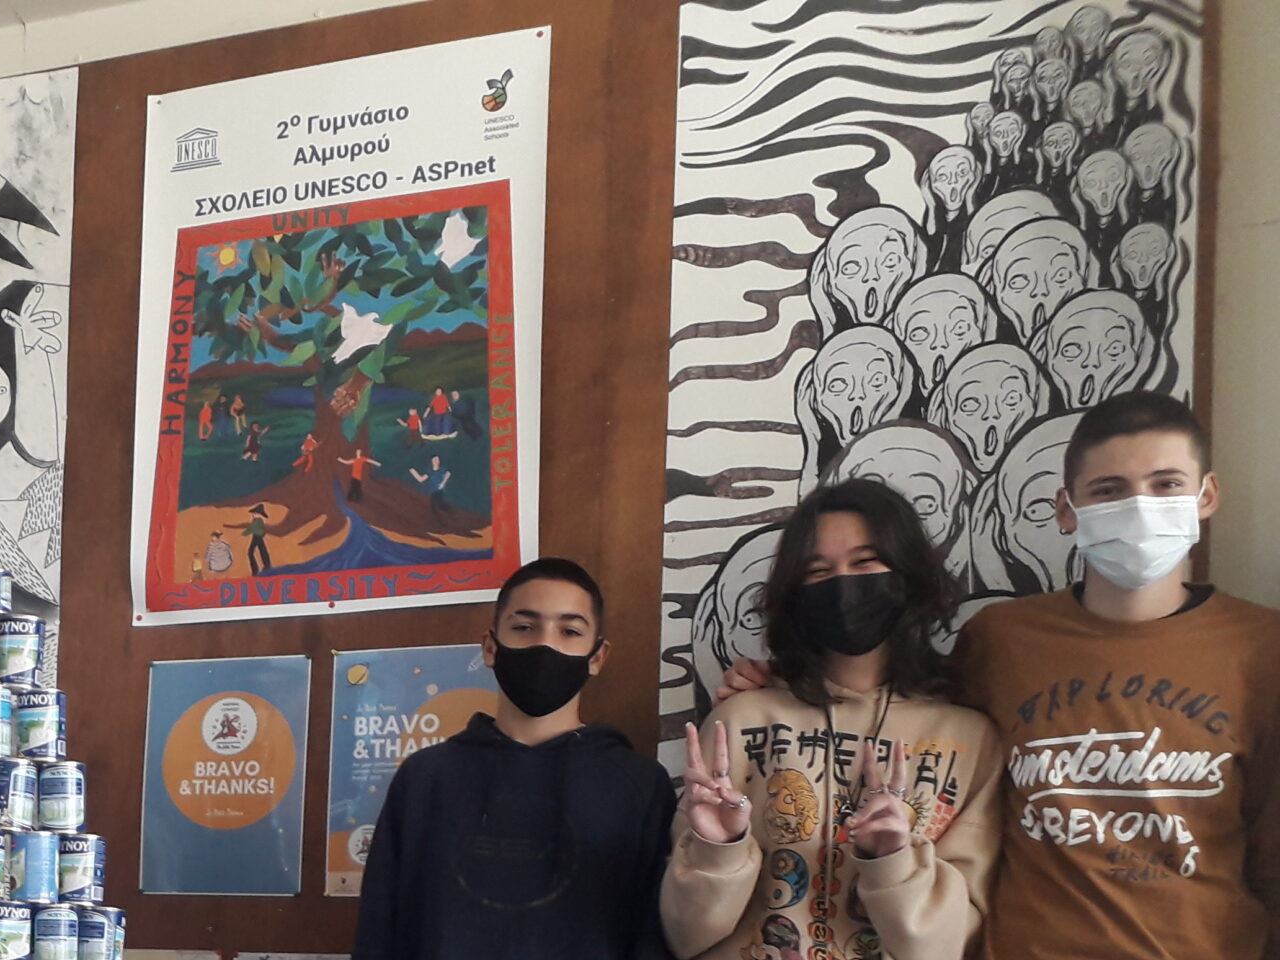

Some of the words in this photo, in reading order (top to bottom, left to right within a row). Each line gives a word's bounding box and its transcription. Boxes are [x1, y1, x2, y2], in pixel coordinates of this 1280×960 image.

[307, 105, 410, 136] Γυμνάσιο
[484, 114, 516, 125] UNESCO
[484, 122, 520, 133] Associated
[484, 132, 510, 141] Schools
[176, 138, 218, 163] UNESCO
[293, 133, 391, 166] Αλμυρού
[194, 186, 288, 217] ΣΧΟΛΕΙΟ
[294, 171, 388, 202] UNESCO
[411, 155, 497, 185] ASPnet
[272, 204, 351, 231] UNITY
[160, 268, 196, 437] HARMONY
[491, 312, 516, 491] TOLERANCE
[219, 574, 400, 607] DIVERSITY
[353, 713, 440, 737] BRAVO
[194, 760, 261, 777] BRAVO
[179, 776, 275, 796] &THANKS!
[61, 840, 91, 852] YNOY
